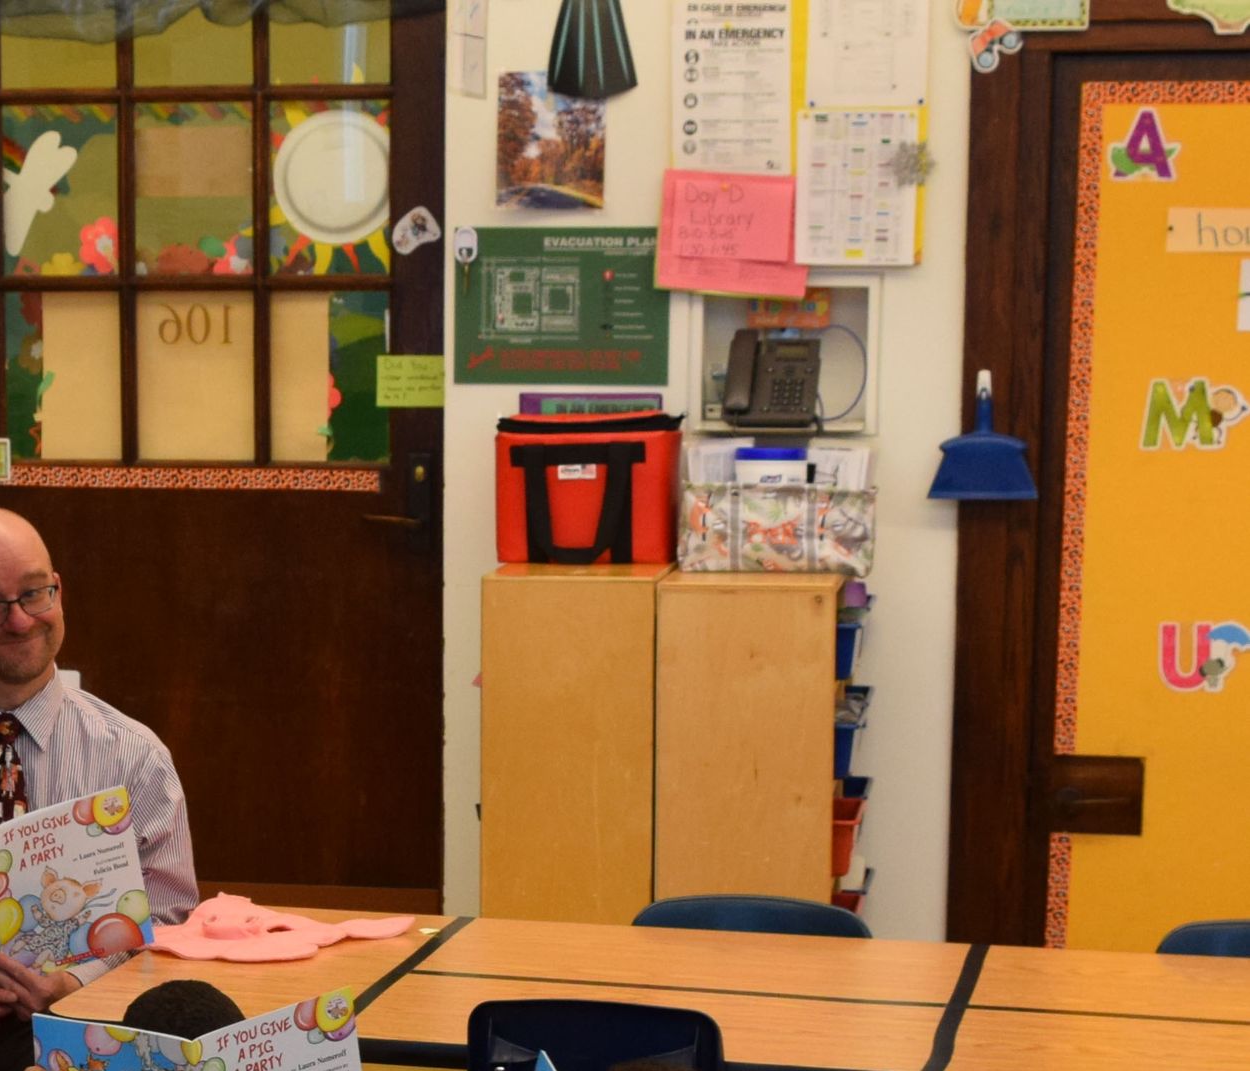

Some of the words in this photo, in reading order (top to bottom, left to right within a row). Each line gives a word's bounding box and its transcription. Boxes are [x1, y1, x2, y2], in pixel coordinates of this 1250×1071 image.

[685, 29, 696, 40] IN
[699, 29, 715, 40] AN
[718, 28, 785, 39] EMERGENCY
[1113, 110, 1173, 179] A
[543, 236, 623, 247] EVACUATION
[1142, 379, 1216, 448] M
[3, 828, 16, 845] IF
[17, 821, 40, 839] YOU
[43, 813, 71, 830] GIVE
[22, 838, 31, 854] A
[32, 833, 56, 849] PIG
[19, 856, 28, 872] A
[30, 845, 65, 866] PARTY
[216, 1033, 230, 1053] IF
[232, 1025, 259, 1047] YOU
[260, 1015, 292, 1038] GIVE
[237, 1047, 247, 1064] A
[248, 1039, 275, 1060] PIG
[298, 1058, 317, 1071] Laura
[317, 1048, 348, 1066] Numeroff
